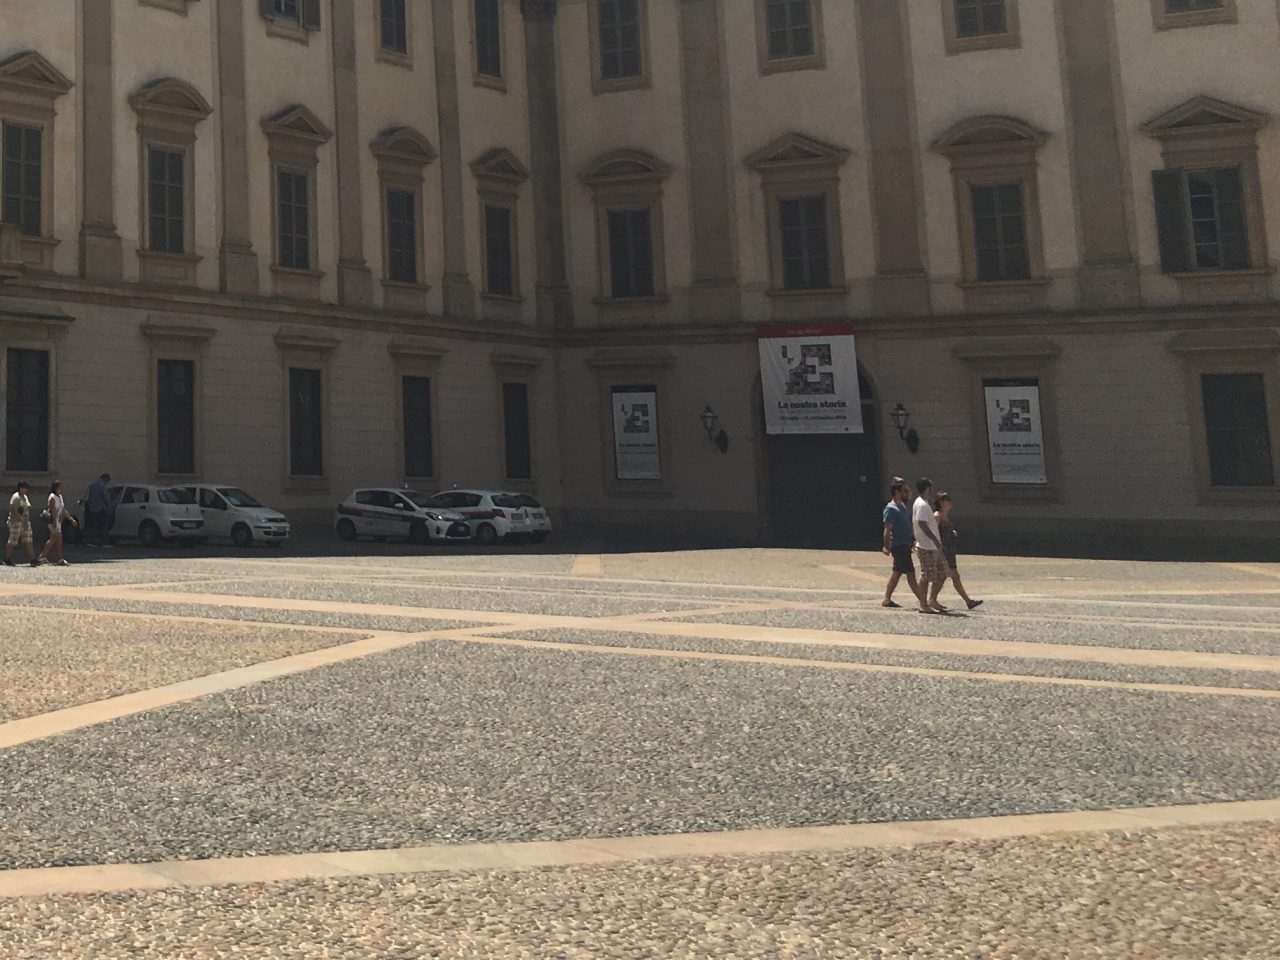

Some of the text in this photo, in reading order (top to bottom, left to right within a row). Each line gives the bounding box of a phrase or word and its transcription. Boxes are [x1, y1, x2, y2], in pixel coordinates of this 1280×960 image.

[778, 400, 847, 409] La nostra storia
